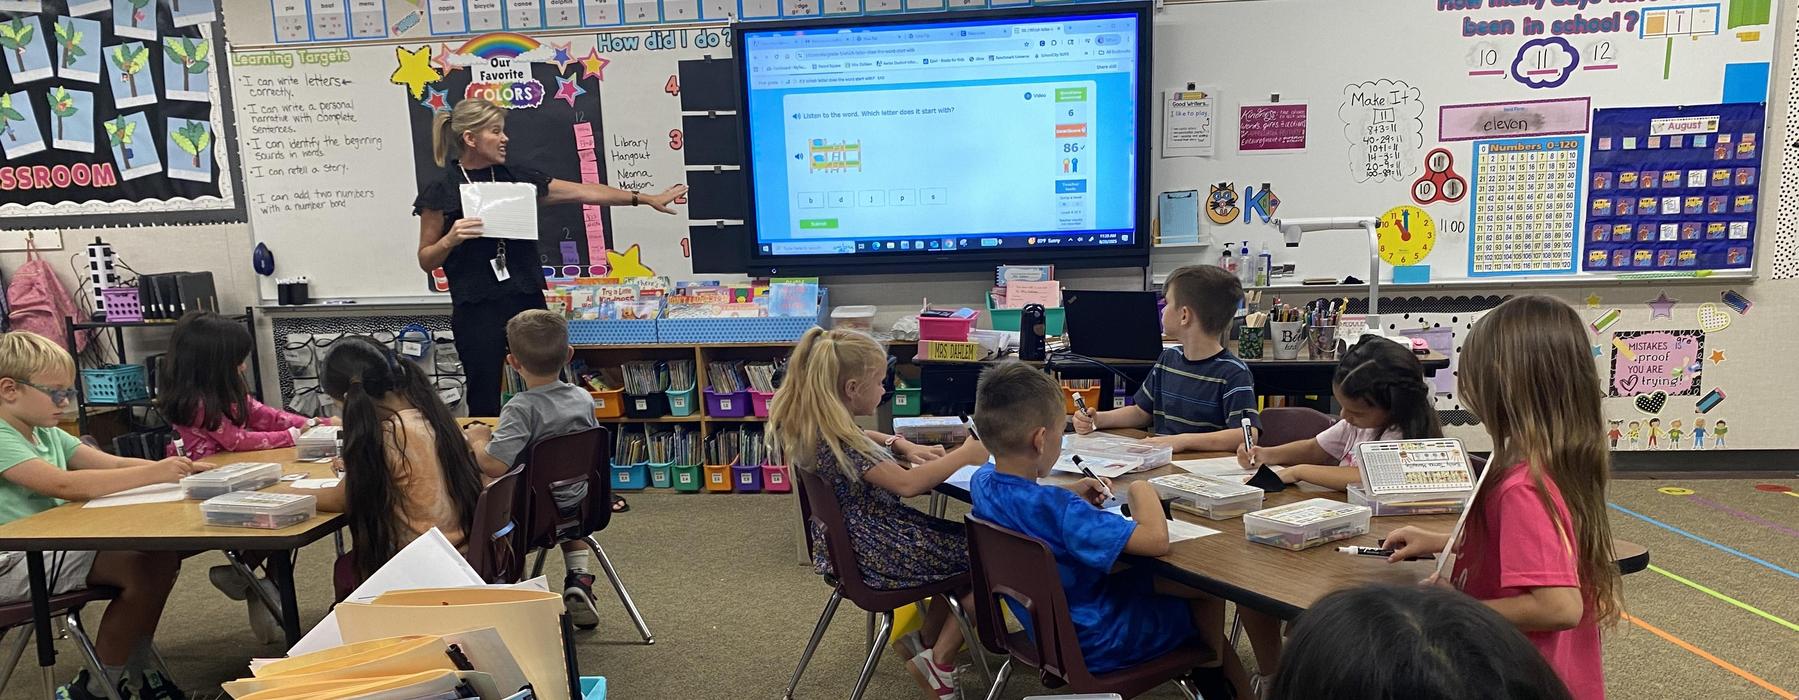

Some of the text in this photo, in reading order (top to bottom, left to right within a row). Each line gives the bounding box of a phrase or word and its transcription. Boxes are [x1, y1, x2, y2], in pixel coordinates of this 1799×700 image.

[1463, 17, 1514, 37] been
[1523, 17, 1544, 35] in
[596, 32, 639, 53] How
[644, 30, 676, 50] did
[680, 29, 687, 48] I
[232, 48, 350, 68] Learning Targets
[1479, 49, 1497, 66] 10
[1594, 41, 1612, 61] 12
[490, 58, 510, 68] Our
[1537, 49, 1547, 69] 11
[243, 76, 253, 86] I
[277, 76, 299, 85] write
[305, 72, 341, 87] letters
[480, 69, 524, 80] Favorite
[664, 75, 680, 96] 4
[250, 86, 294, 100] correctly.
[474, 87, 532, 101] COLORS
[1351, 90, 1408, 107] Make It
[248, 104, 257, 114] I
[261, 105, 279, 113] can
[282, 103, 304, 112] write
[320, 100, 354, 113] personal
[251, 113, 288, 123] narrative
[294, 113, 312, 123] with
[1380, 111, 1387, 120] 11
[1667, 121, 1701, 131] August
[251, 138, 261, 149] I
[266, 141, 284, 149] can
[289, 137, 320, 151] identify
[323, 135, 340, 147] the
[614, 134, 648, 150] Library
[669, 128, 683, 150] 3
[1547, 140, 1578, 149] 0-120
[1064, 142, 1079, 153] 86
[255, 151, 285, 160] sounds
[611, 150, 650, 166] Hangout
[252, 166, 264, 178] I
[288, 165, 308, 175] retell
[620, 181, 654, 189] Madison
[1420, 183, 1431, 195] 10
[256, 188, 374, 204] I can add two numbers
[260, 204, 280, 214] with
[295, 201, 326, 211] number
[563, 227, 572, 240] 2
[680, 237, 690, 258] 1
[1676, 336, 1692, 344] are
[950, 343, 974, 359] DAHLEM
[1638, 352, 1670, 364] proof
[1628, 365, 1663, 374] YOU ARE
[1642, 375, 1683, 387] trying!
